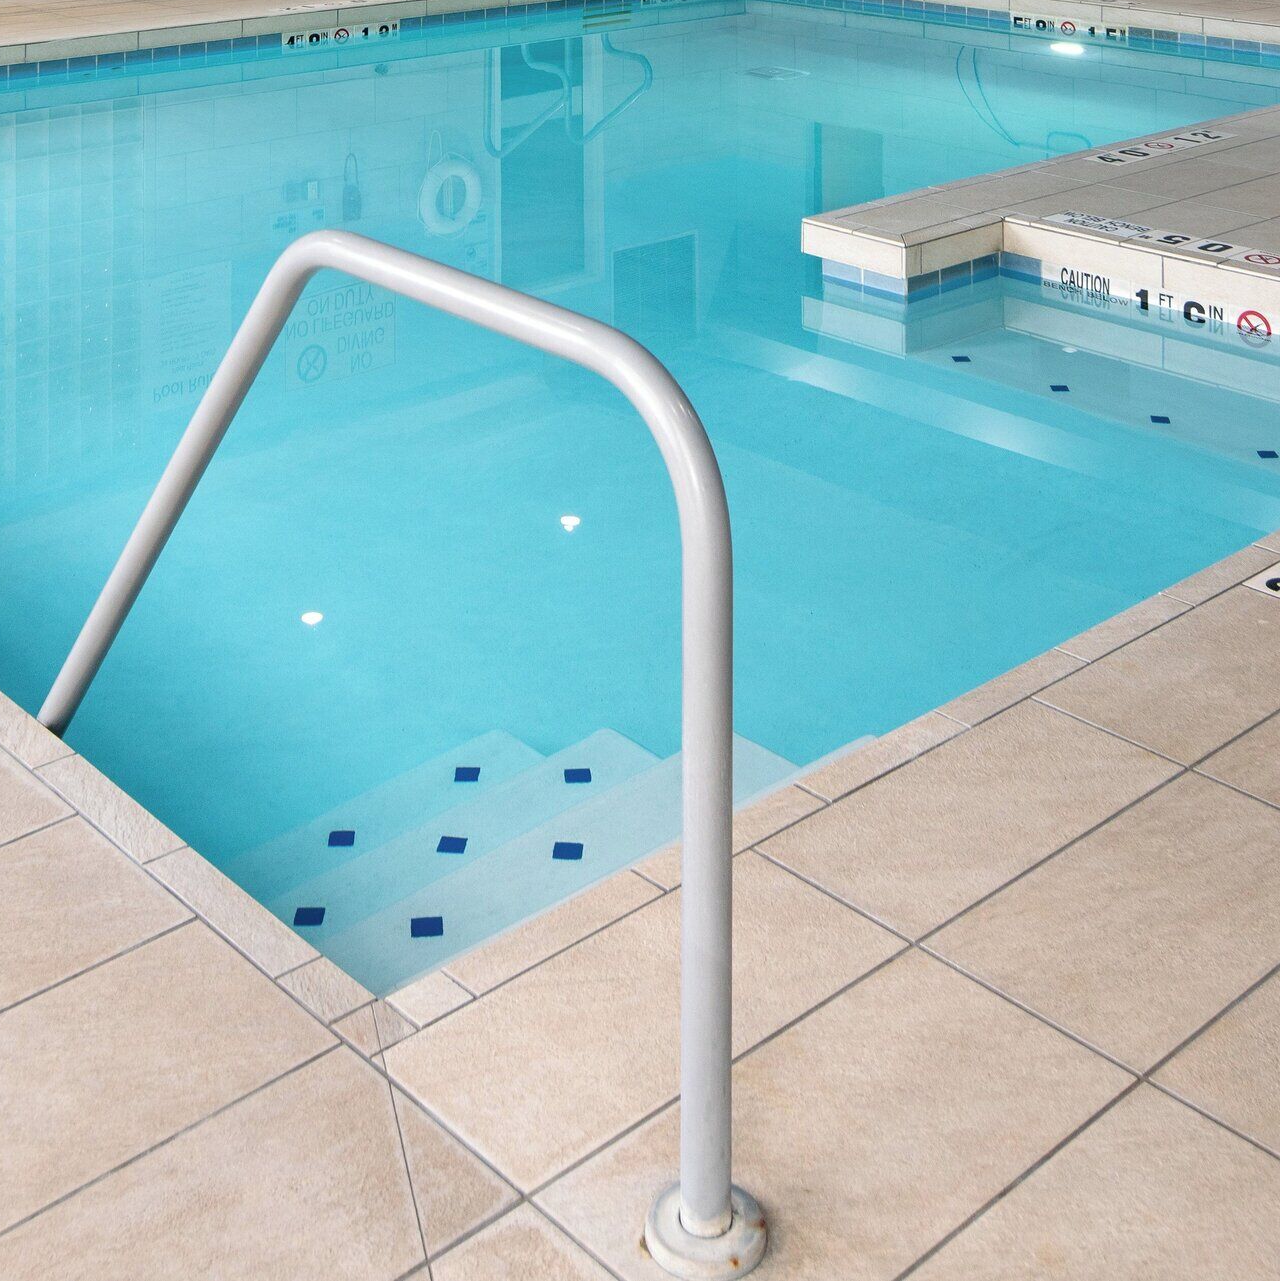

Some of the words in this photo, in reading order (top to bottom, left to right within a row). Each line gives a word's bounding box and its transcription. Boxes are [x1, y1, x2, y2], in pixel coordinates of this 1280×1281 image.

[1063, 211, 1105, 223] BELOW
[1065, 218, 1119, 232] CAUTION
[1106, 220, 1151, 233] BENCH
[1061, 267, 1110, 295] CAUTION
[1043, 280, 1084, 296] BENCH
[1087, 290, 1129, 307] BELOW
[1135, 288, 1149, 311] 1
[1159, 293, 1174, 308] FT
[1209, 305, 1223, 320] IN
